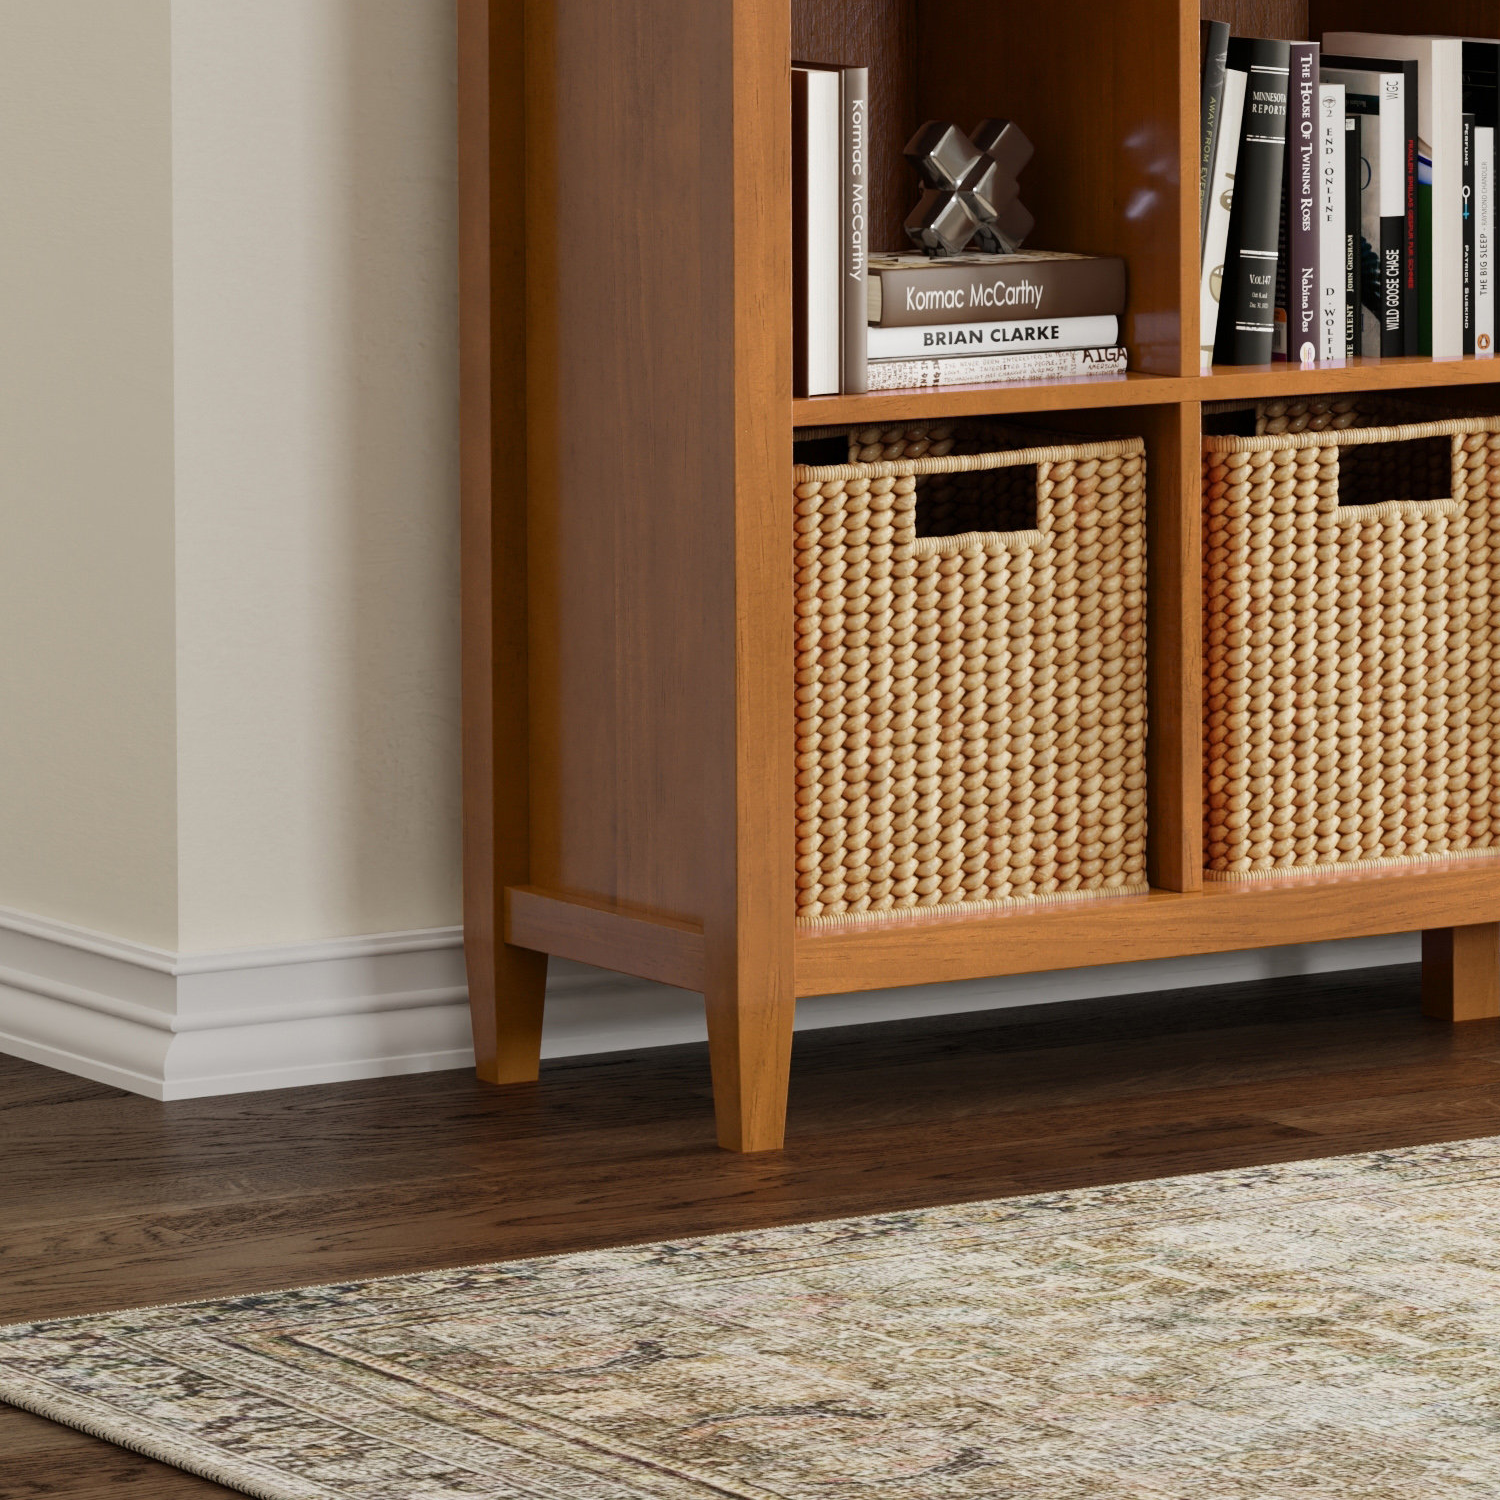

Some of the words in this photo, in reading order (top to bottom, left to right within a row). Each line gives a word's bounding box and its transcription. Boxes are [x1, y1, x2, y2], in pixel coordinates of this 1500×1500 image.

[1300, 53, 1313, 78] THE
[1300, 81, 1313, 119] HOUSE
[1385, 80, 1399, 100] WGC
[1207, 96, 1217, 127] AWAY
[1252, 103, 1287, 116] REPORTS
[1326, 109, 1333, 118] 2
[852, 99, 864, 176] Kormac
[1202, 130, 1213, 163] FROM
[1300, 142, 1313, 195] TWINING
[1480, 161, 1488, 194] CHANDLER
[1300, 198, 1313, 232] ROSES
[1480, 195, 1488, 226] RAYMOND
[849, 183, 864, 282] McCarthy
[1479, 233, 1488, 258] SLEEP
[1346, 234, 1354, 271] GRISHAM
[1386, 249, 1400, 277] CHASE
[1479, 260, 1488, 276] BIG
[906, 286, 965, 311] Kormac
[969, 279, 1044, 310] McCarthy
[1302, 267, 1314, 309] Nabina
[1346, 272, 1354, 293] JOHN
[1386, 278, 1400, 306] GOOSE
[1479, 279, 1488, 296] THE
[1301, 310, 1314, 333] Das
[1346, 304, 1354, 341] CLIENT
[1385, 308, 1400, 331] WILD
[923, 329, 983, 347] BRIAN
[990, 325, 1060, 342] CLARKE
[1082, 348, 1127, 364] AIGA
